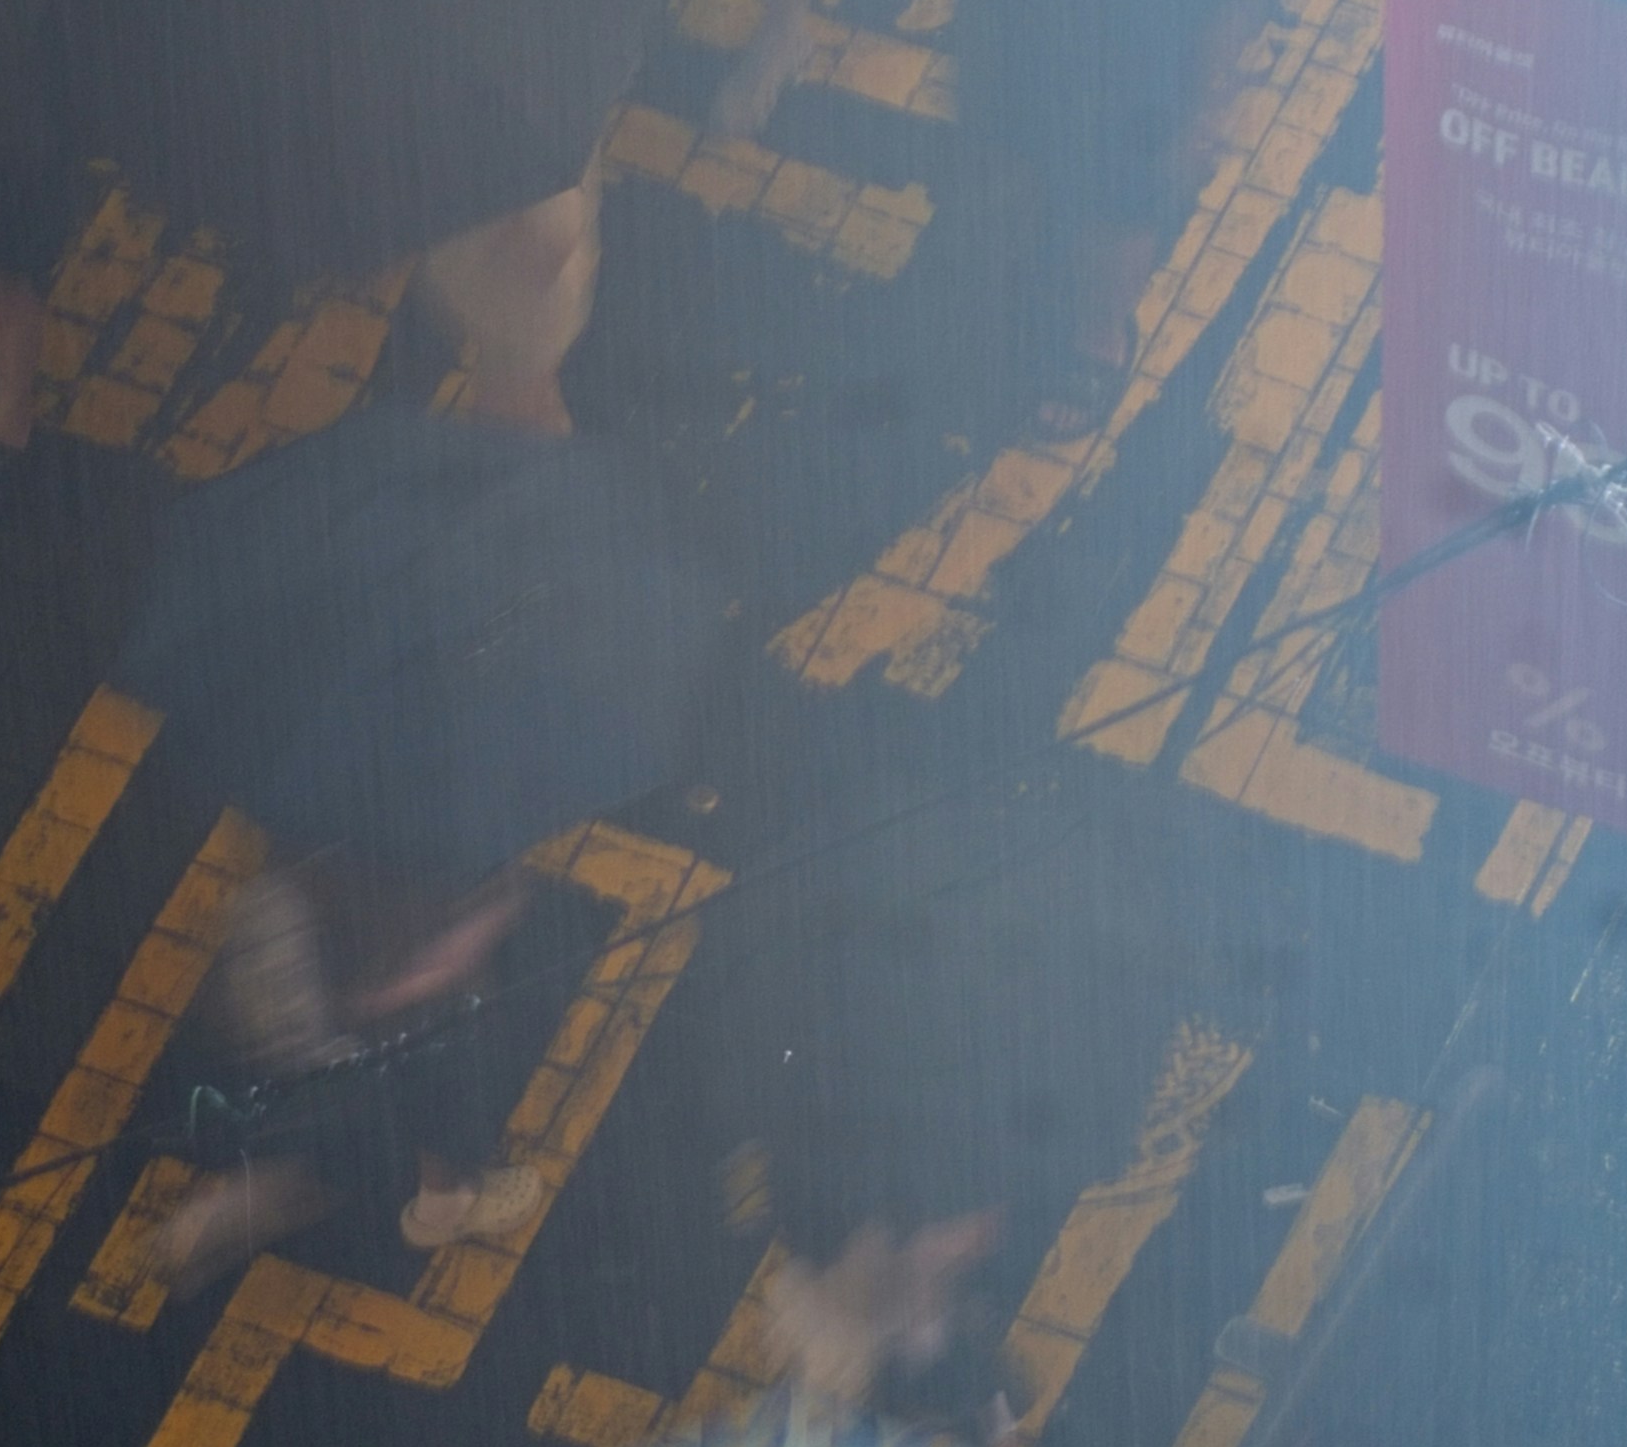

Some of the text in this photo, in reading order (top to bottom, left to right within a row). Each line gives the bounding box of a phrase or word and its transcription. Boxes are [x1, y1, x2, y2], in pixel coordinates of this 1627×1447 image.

[1440, 107, 1521, 168] OFF
[1448, 341, 1581, 425] UP TO
[1506, 662, 1607, 756] %
